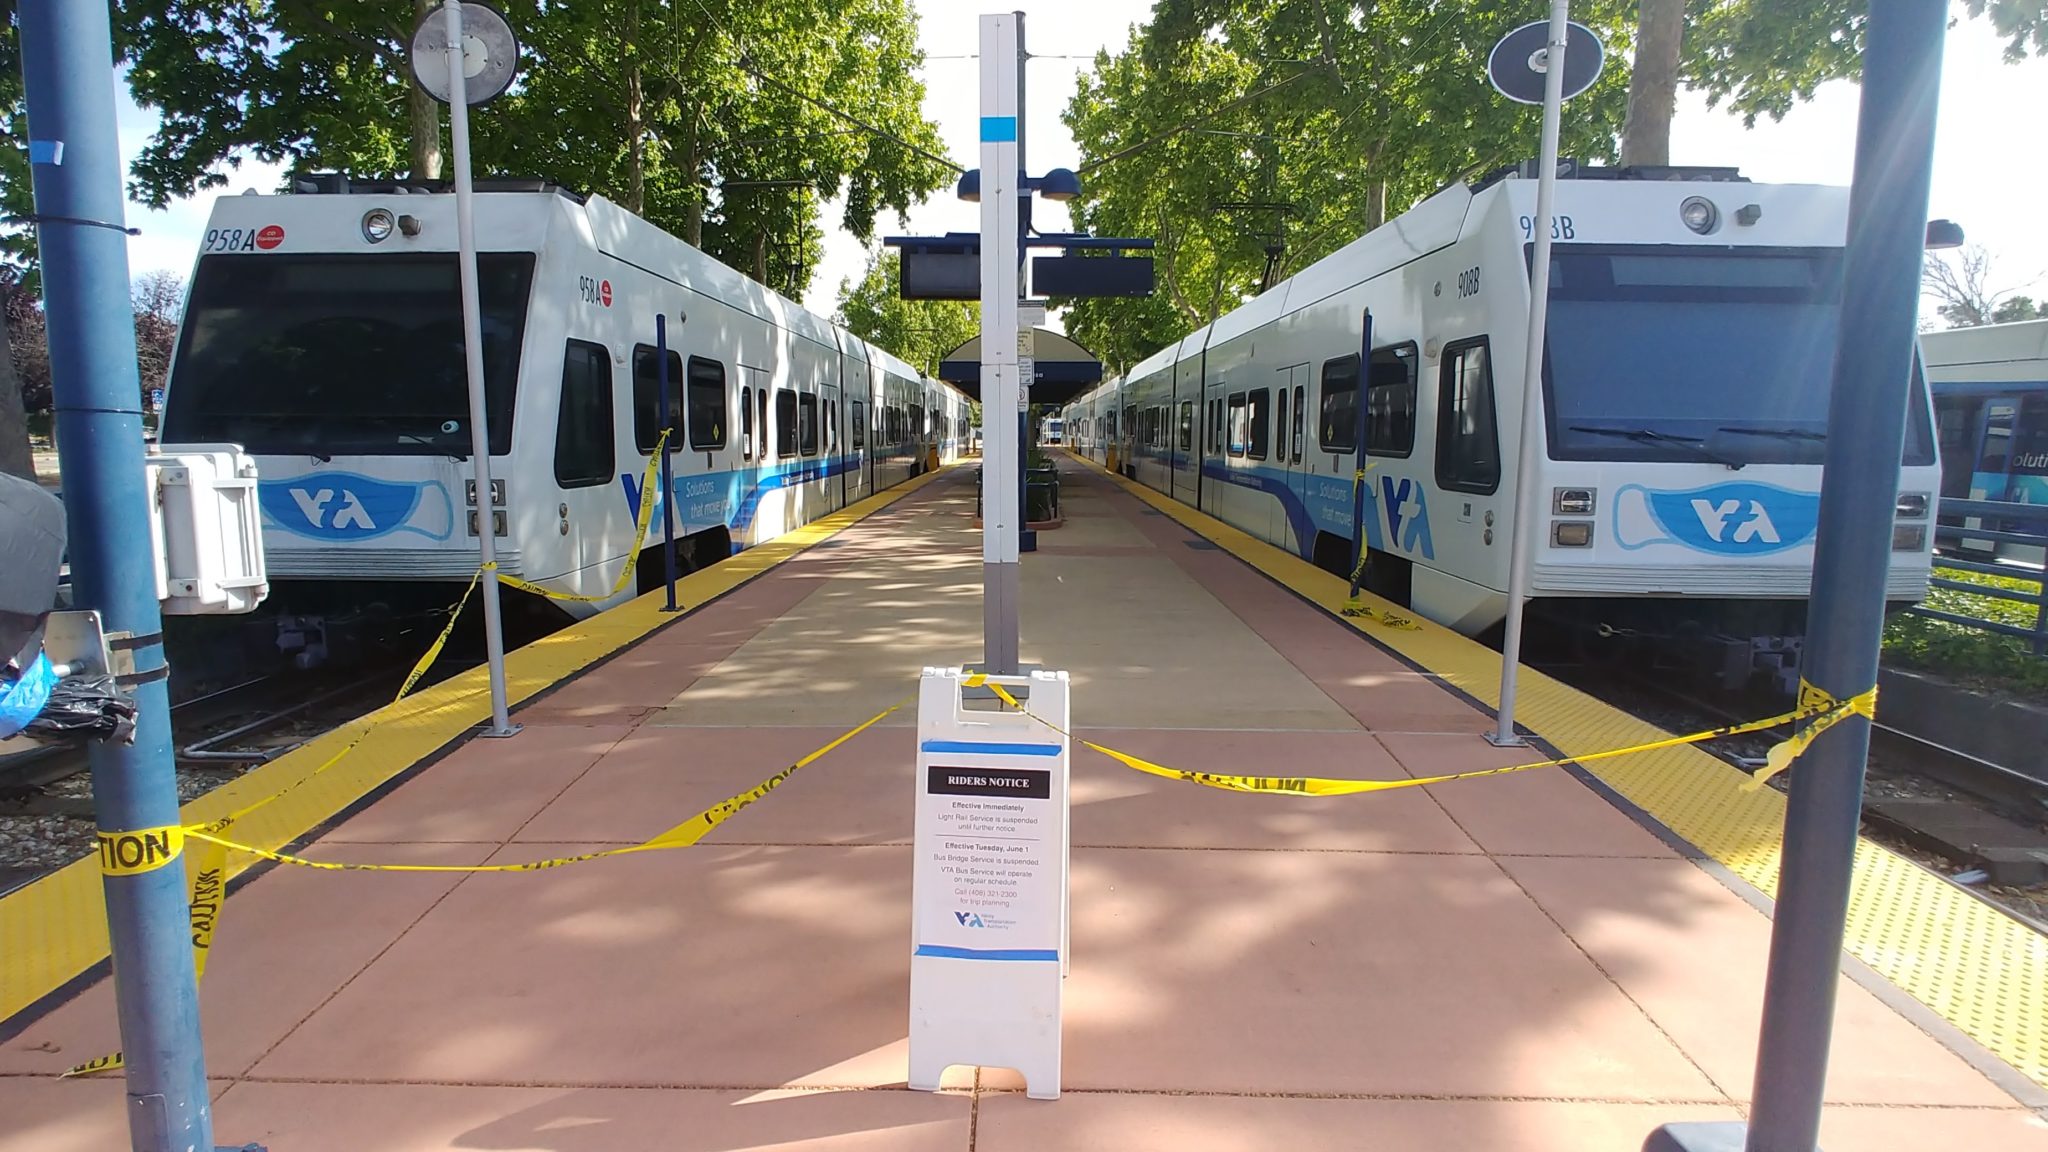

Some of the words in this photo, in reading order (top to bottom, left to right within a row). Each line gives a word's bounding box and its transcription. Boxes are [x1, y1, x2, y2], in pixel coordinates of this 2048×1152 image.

[206, 229, 255, 251] 958A
[1458, 266, 1480, 299] 908B
[580, 275, 602, 307] 958A
[686, 480, 715, 498] Solutions
[289, 488, 377, 529] VTA
[691, 502, 704, 519] that
[704, 502, 720, 516] move
[1690, 499, 1782, 543] VTA
[948, 775, 987, 786] RIDERS
[988, 778, 1030, 788] NOTICE
[952, 802, 982, 810] Effective
[982, 803, 1024, 814] Immediately
[938, 814, 954, 822] Light
[970, 814, 994, 823] Service
[1002, 816, 1038, 826] suspended
[972, 824, 994, 832] further
[945, 842, 974, 850] Effective
[976, 844, 1005, 854] Tuesday,
[1006, 845, 1023, 853] June
[934, 854, 946, 862] Bus
[948, 854, 968, 864] Bridge
[970, 856, 994, 864] Service
[1003, 858, 1039, 866] suspended
[940, 866, 954, 874] VTA
[970, 868, 994, 876] Service
[1008, 870, 1032, 879] operate
[964, 877, 986, 886] regular
[988, 878, 1017, 886] schedule
[954, 888, 968, 896] Call
[968, 888, 986, 897] (408)
[986, 890, 1018, 898] 321-2300
[970, 898, 980, 906] trip
[982, 899, 1010, 908] planning
